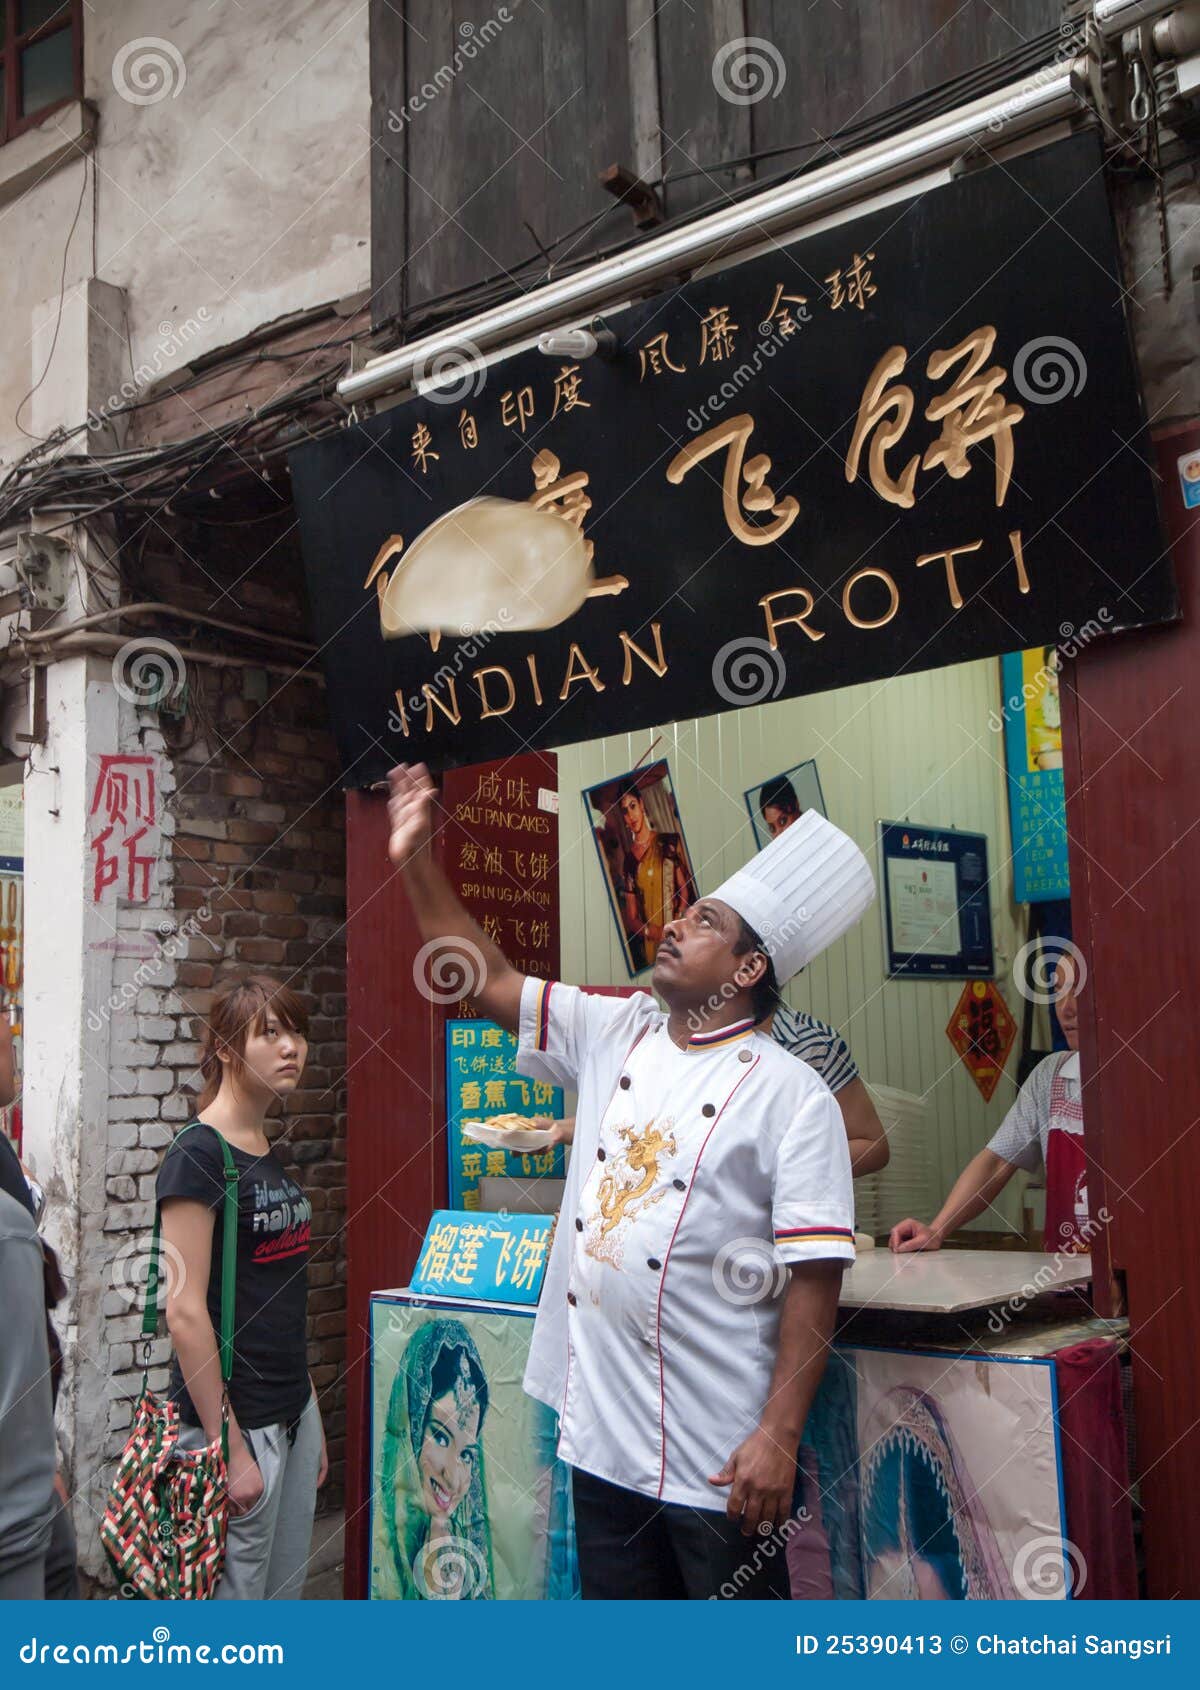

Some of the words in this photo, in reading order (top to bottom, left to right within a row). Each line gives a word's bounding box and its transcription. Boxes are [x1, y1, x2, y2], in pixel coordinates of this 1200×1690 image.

[410, 365, 592, 475] 来自印度
[395, 622, 669, 737] INDIAN
[758, 530, 1030, 652] ROTI
[475, 771, 531, 809] 咸味
[90, 754, 157, 905] 厕所
[456, 804, 482, 824] SALT
[485, 808, 550, 834] PANCAKES
[459, 842, 549, 880] 葱油飞饼
[460, 1081, 554, 1110] 香蕉飞饼
[419, 1223, 551, 1291] 榴莲飞饼
